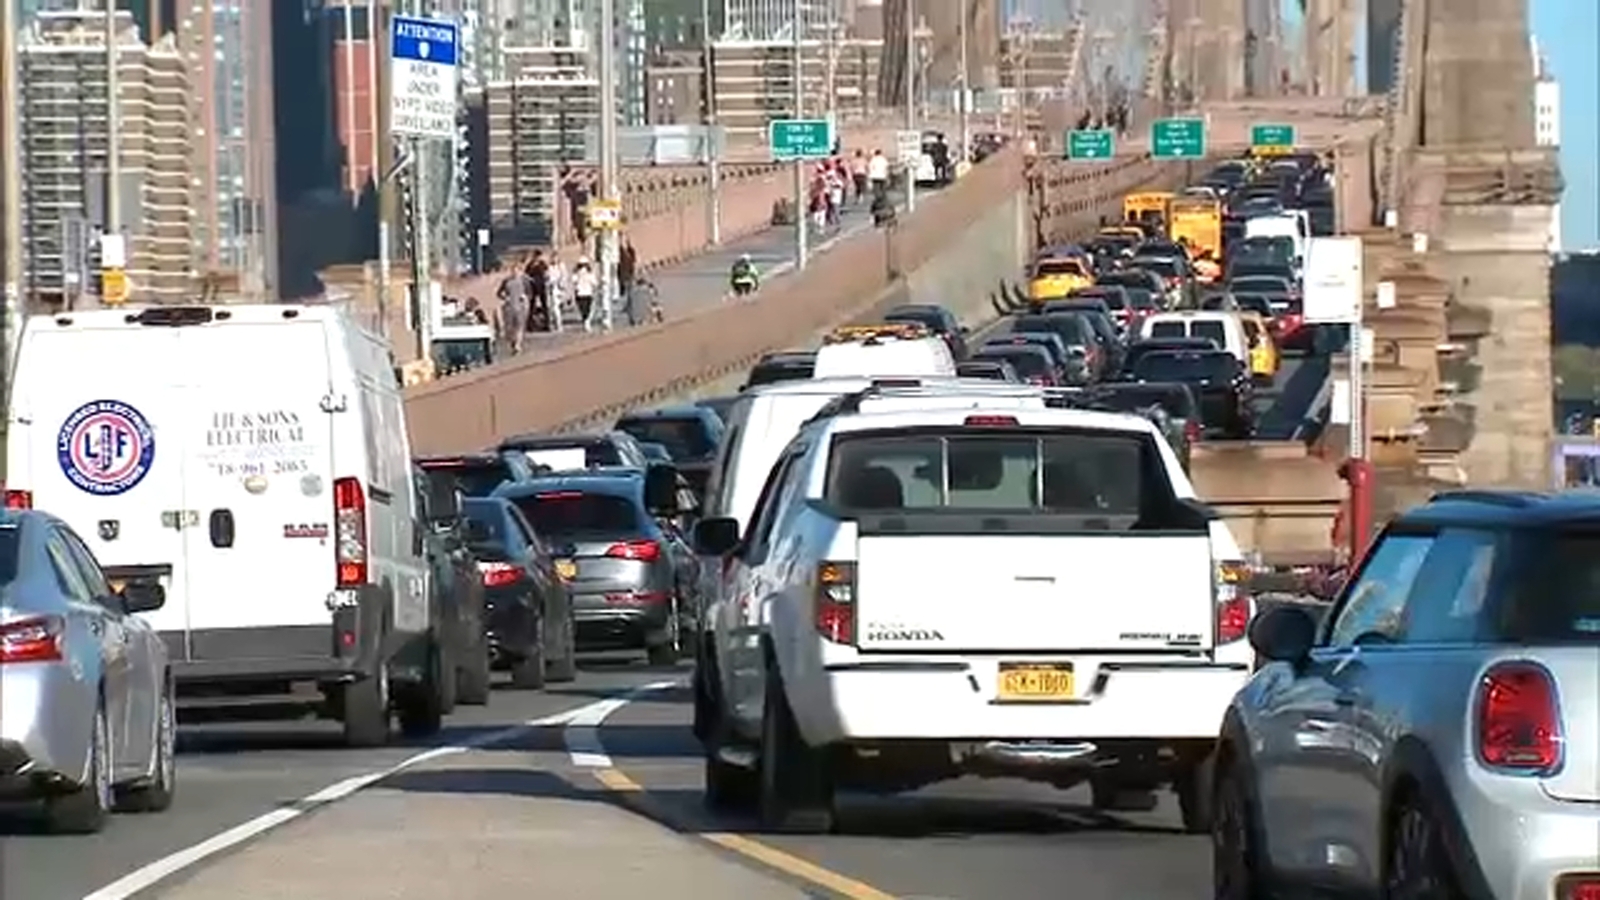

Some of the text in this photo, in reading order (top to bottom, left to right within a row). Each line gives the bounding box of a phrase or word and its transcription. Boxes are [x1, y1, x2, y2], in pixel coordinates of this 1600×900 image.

[396, 22, 454, 43] ATTENTION
[409, 63, 438, 78] AREA
[867, 629, 945, 641] HONDA
